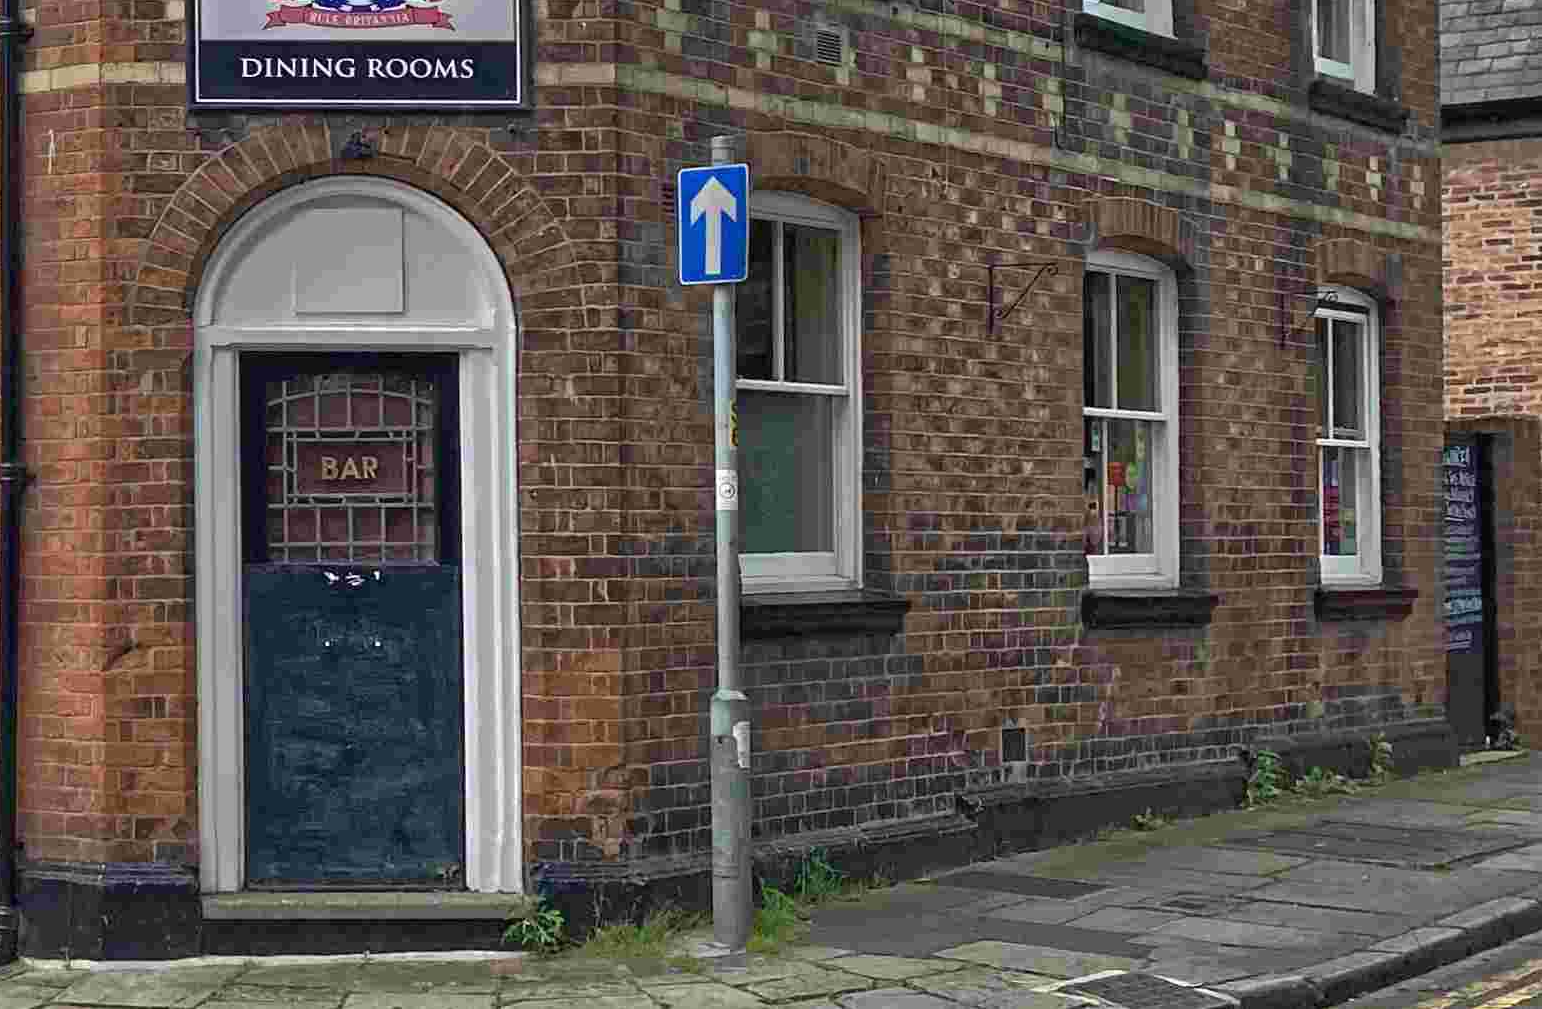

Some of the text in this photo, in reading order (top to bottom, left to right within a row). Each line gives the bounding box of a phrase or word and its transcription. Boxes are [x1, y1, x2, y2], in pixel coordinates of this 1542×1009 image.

[240, 57, 475, 79] DINING ROOMS
[321, 456, 379, 480] BAR
